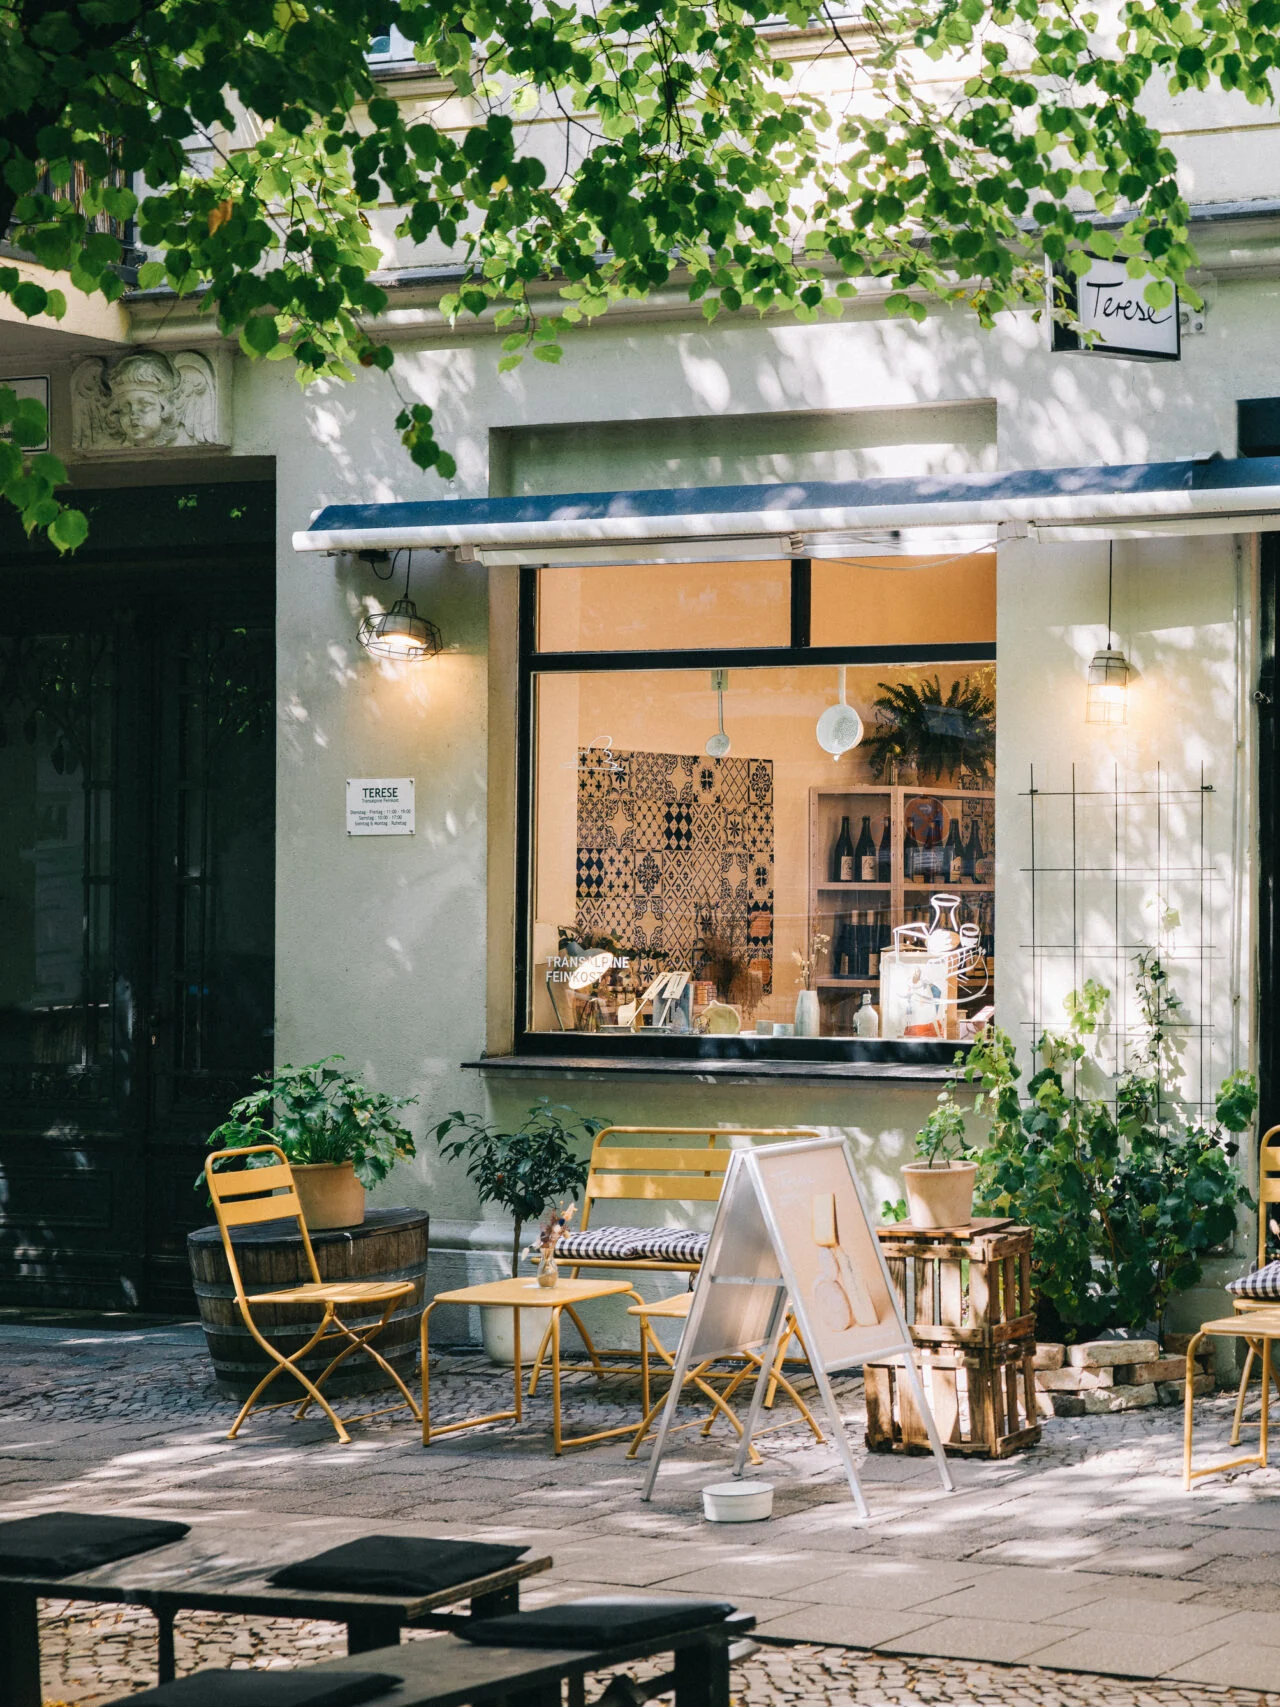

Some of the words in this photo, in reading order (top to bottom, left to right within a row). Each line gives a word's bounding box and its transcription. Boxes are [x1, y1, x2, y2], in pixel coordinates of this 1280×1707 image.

[1086, 281, 1173, 325] Terese
[362, 787, 399, 798] TERESE
[546, 956, 630, 968] TRANSALPINE
[546, 971, 603, 982] FEINKOST
